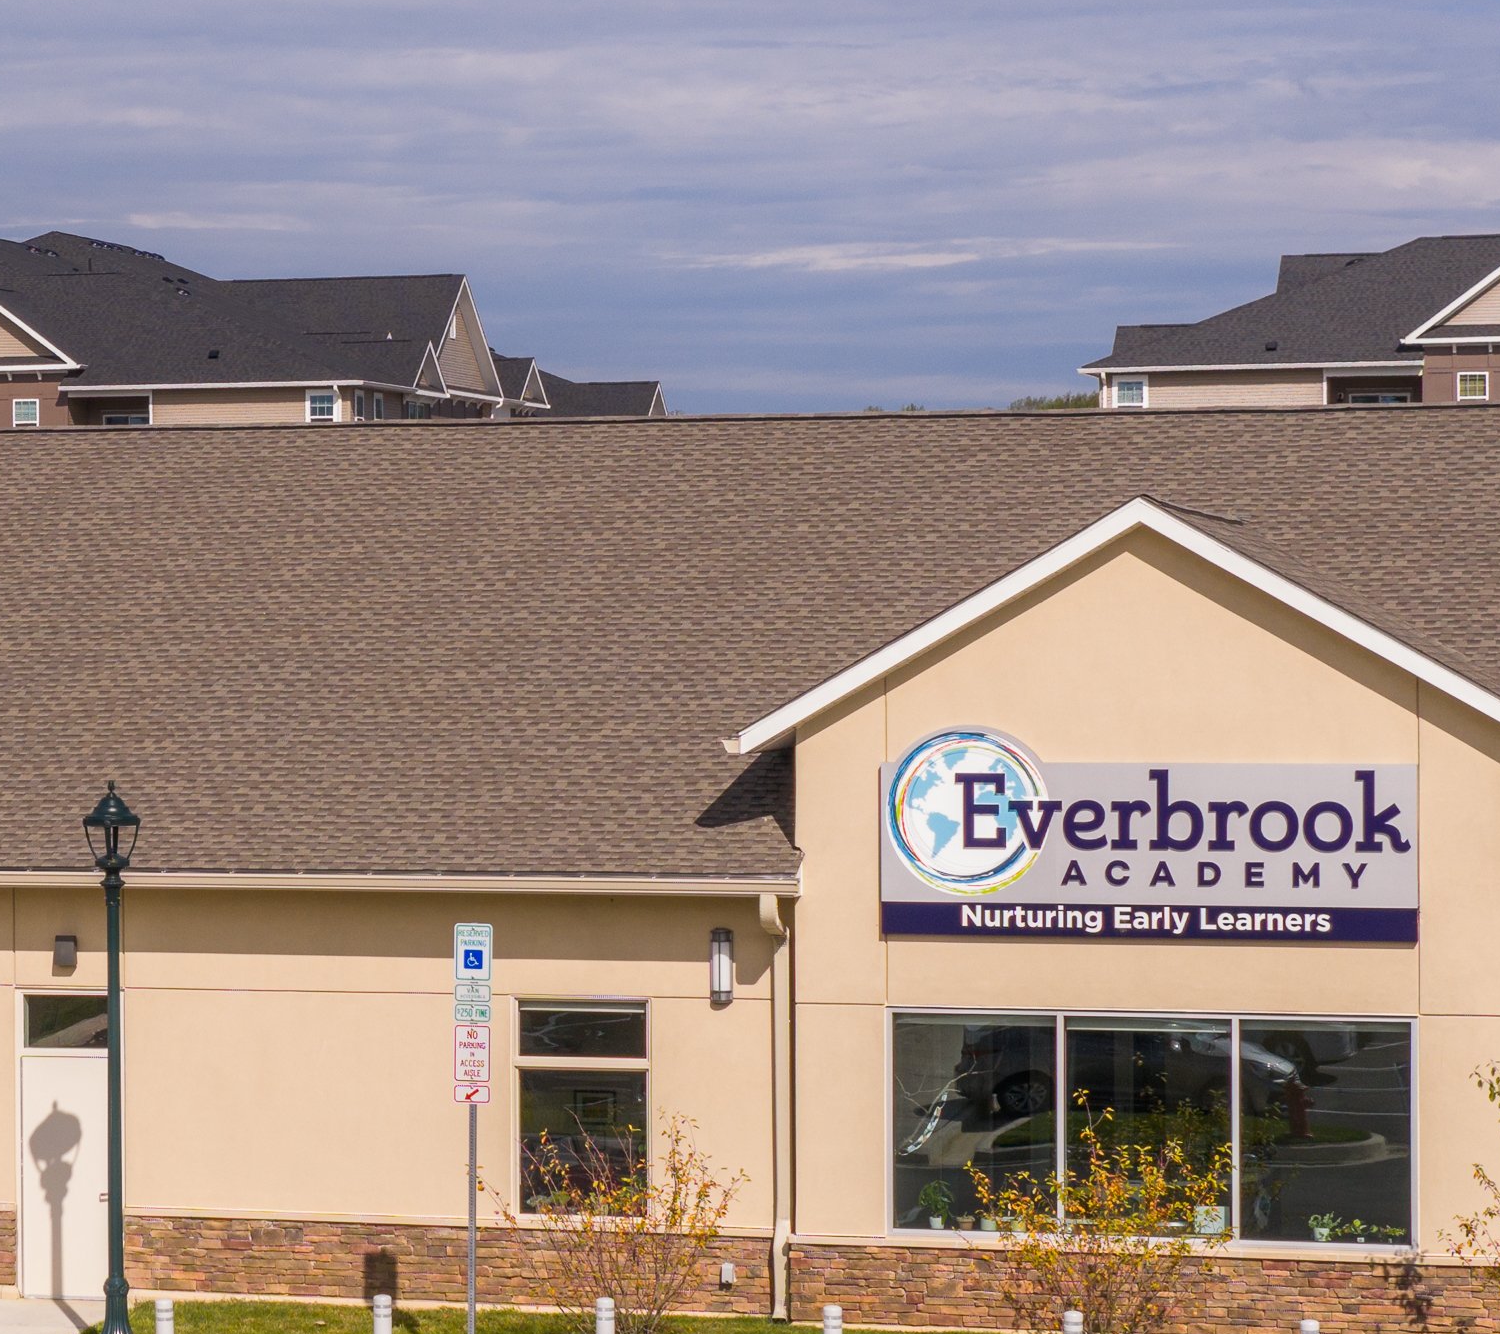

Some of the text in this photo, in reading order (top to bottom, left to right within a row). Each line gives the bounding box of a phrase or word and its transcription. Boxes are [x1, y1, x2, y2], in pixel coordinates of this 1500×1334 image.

[954, 768, 1411, 853] Everbrook
[1061, 859, 1368, 888] ACADEMY
[961, 904, 1331, 934] Nurturing Early Learners
[457, 930, 489, 938] RESERVED
[460, 939, 487, 947] PARKING
[475, 1008, 488, 1018] FINE
[467, 1030, 478, 1040] NO
[459, 1041, 486, 1049] PARKING
[460, 1060, 485, 1068] ACCESS
[464, 1069, 481, 1077] AISLE
